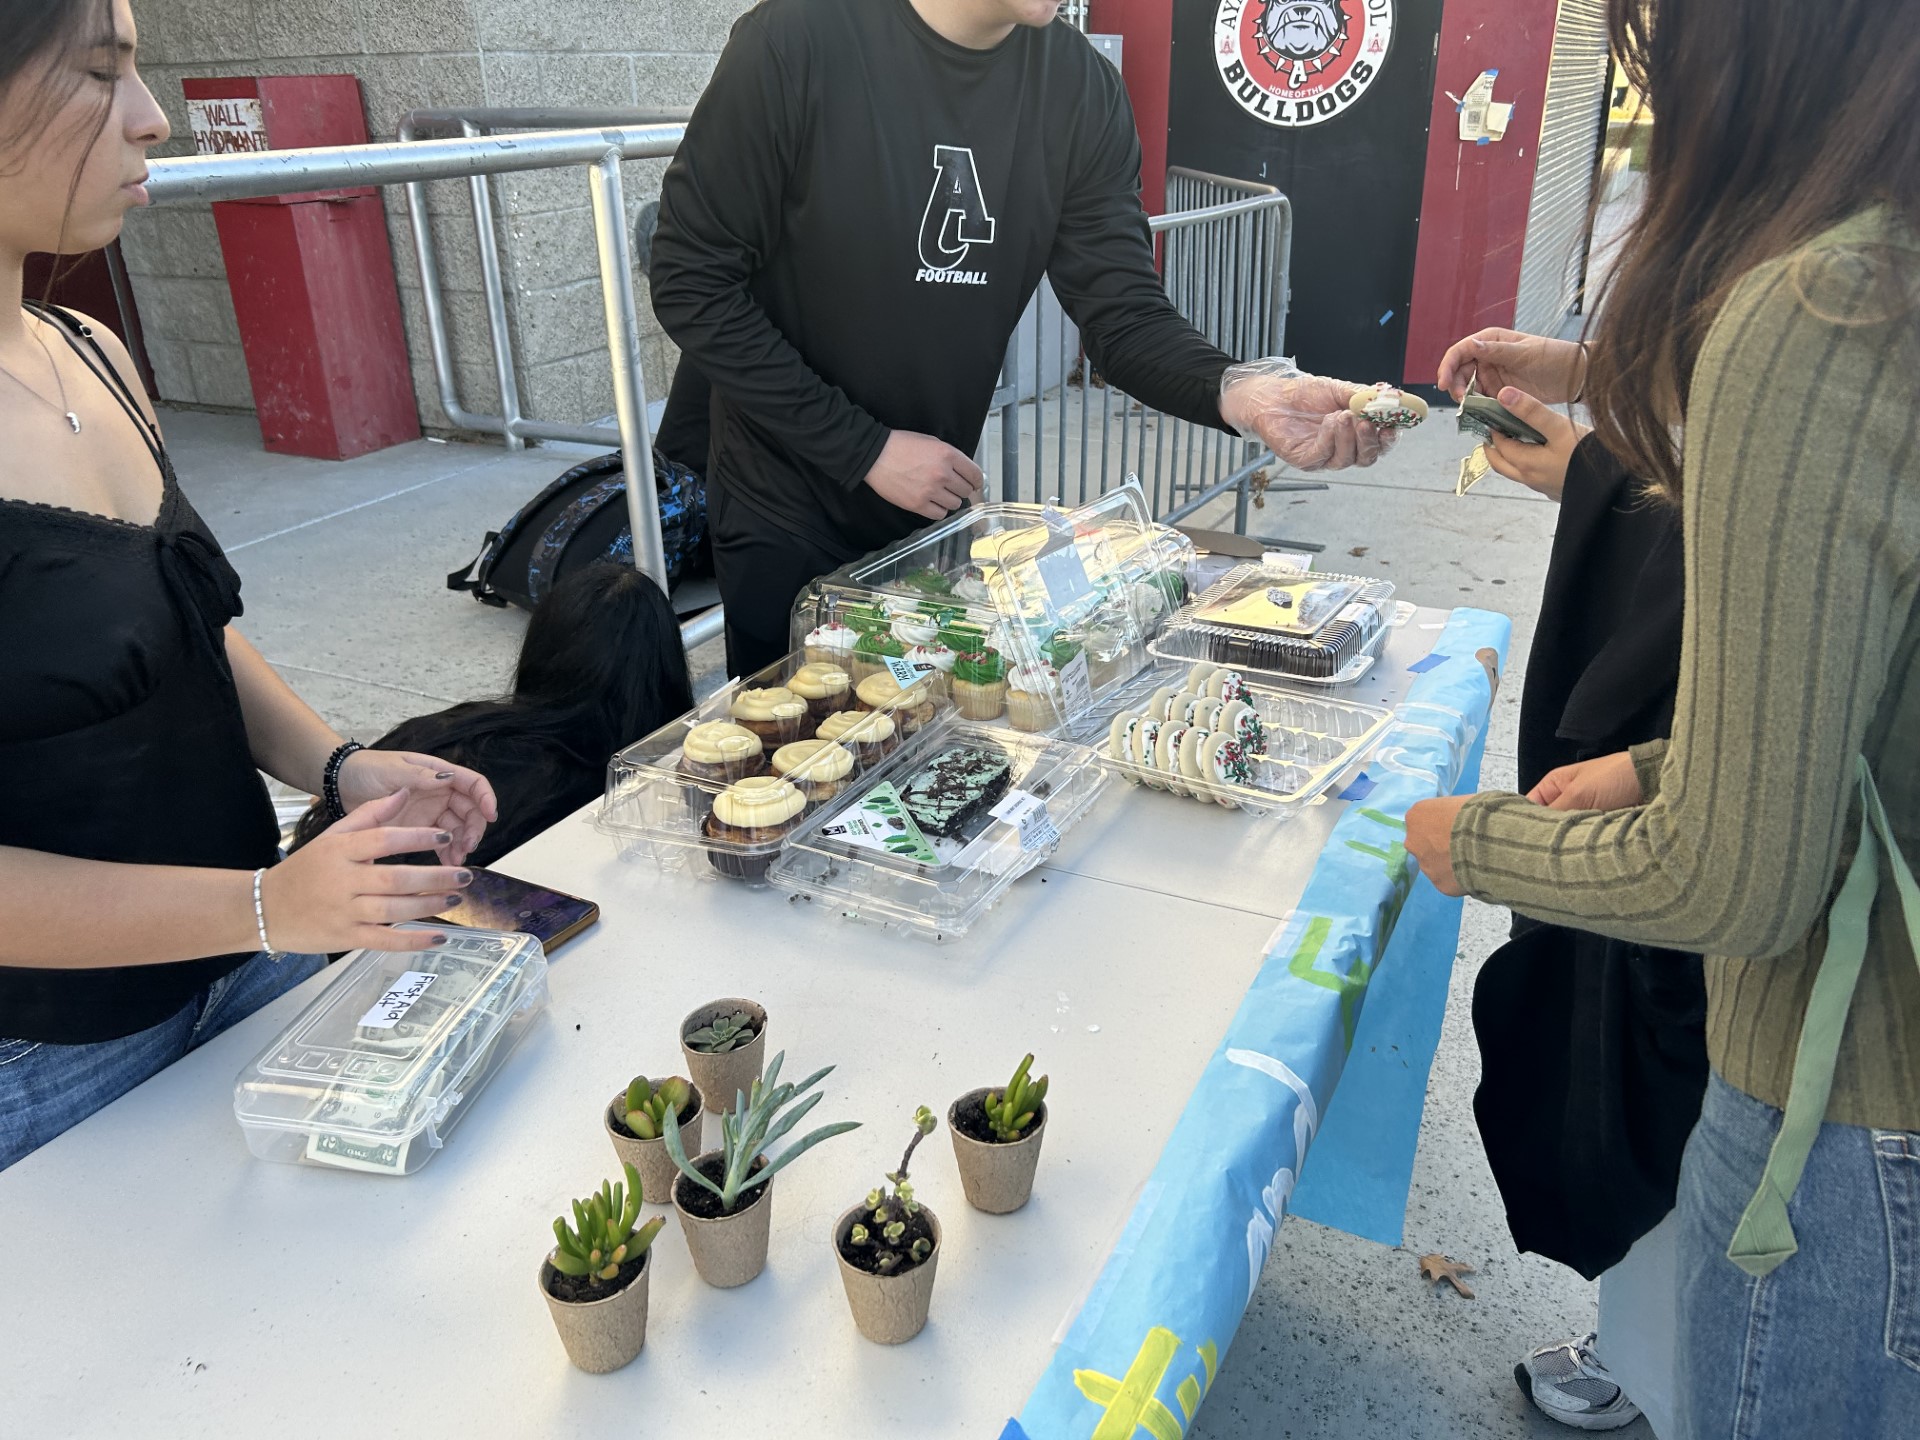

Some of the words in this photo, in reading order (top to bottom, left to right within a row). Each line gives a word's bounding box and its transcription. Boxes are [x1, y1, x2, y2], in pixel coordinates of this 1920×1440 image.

[1221, 0, 1243, 30] AY
[1223, 59, 1373, 123] BULLDOGS
[1268, 84, 1294, 98] HOME
[1294, 90, 1307, 99] OF
[1306, 84, 1324, 97] THE
[203, 104, 247, 126] WALL
[194, 130, 266, 153] HYDRANT
[916, 268, 988, 285] FOOTBALL
[403, 975, 436, 998] First
[378, 991, 404, 1008] Kit
[382, 1000, 411, 1021] Aid
